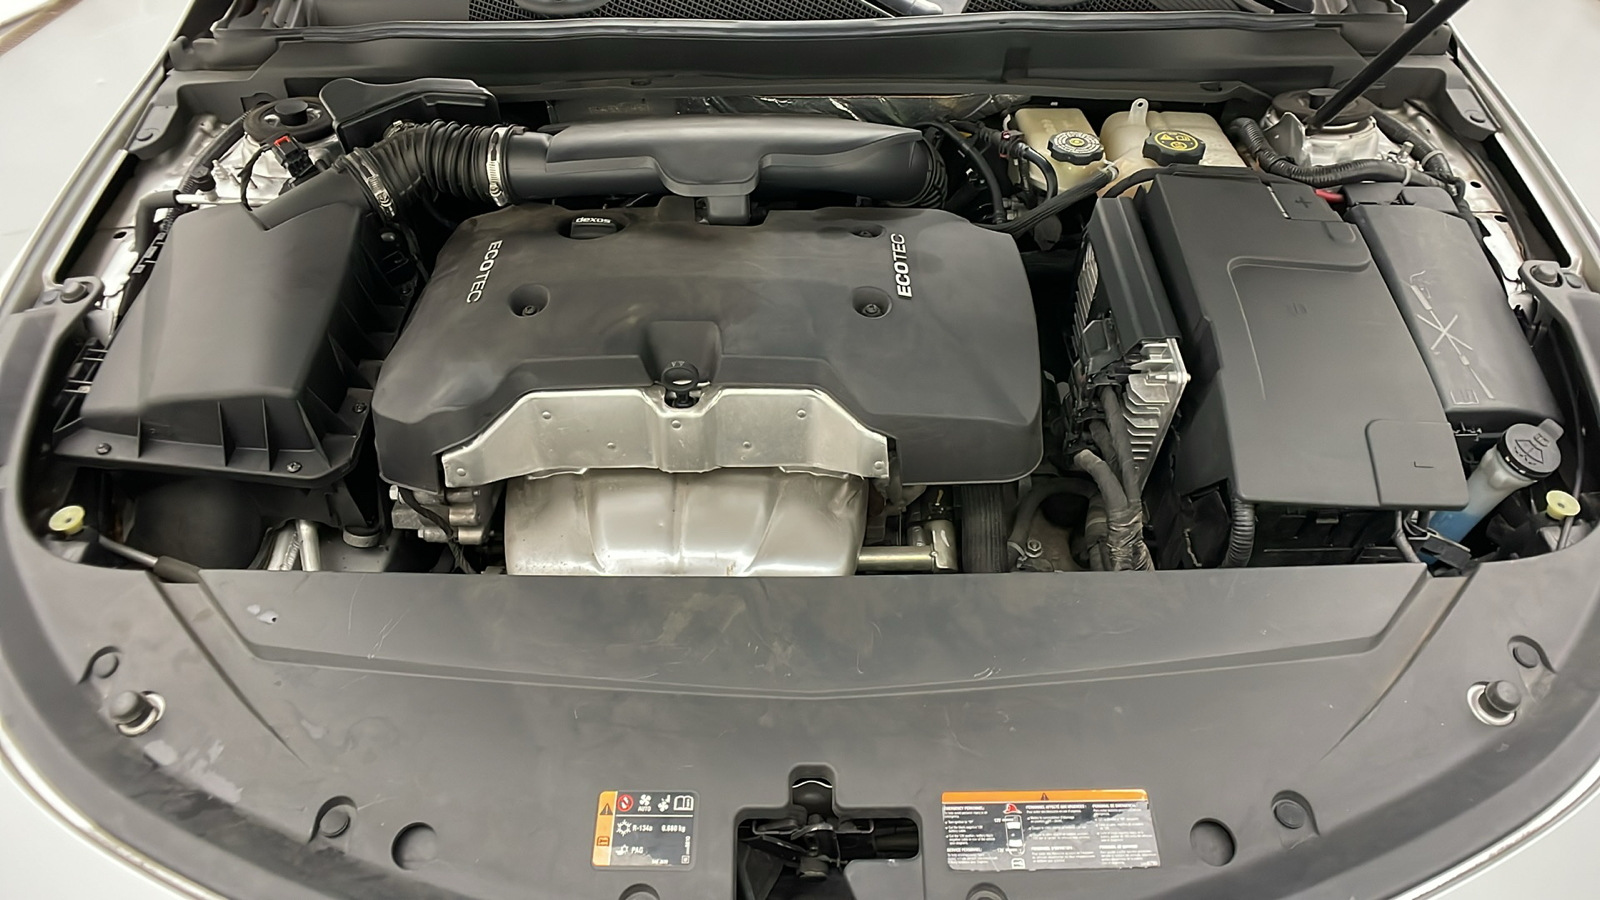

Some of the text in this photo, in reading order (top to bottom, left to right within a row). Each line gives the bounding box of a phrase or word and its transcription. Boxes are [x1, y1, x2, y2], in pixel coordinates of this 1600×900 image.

[575, 216, 612, 224] dexos
[890, 233, 912, 298] ECOTEC
[466, 239, 503, 304] ECOTEC
[632, 824, 653, 832] R-134a
[631, 846, 644, 854] PAG
